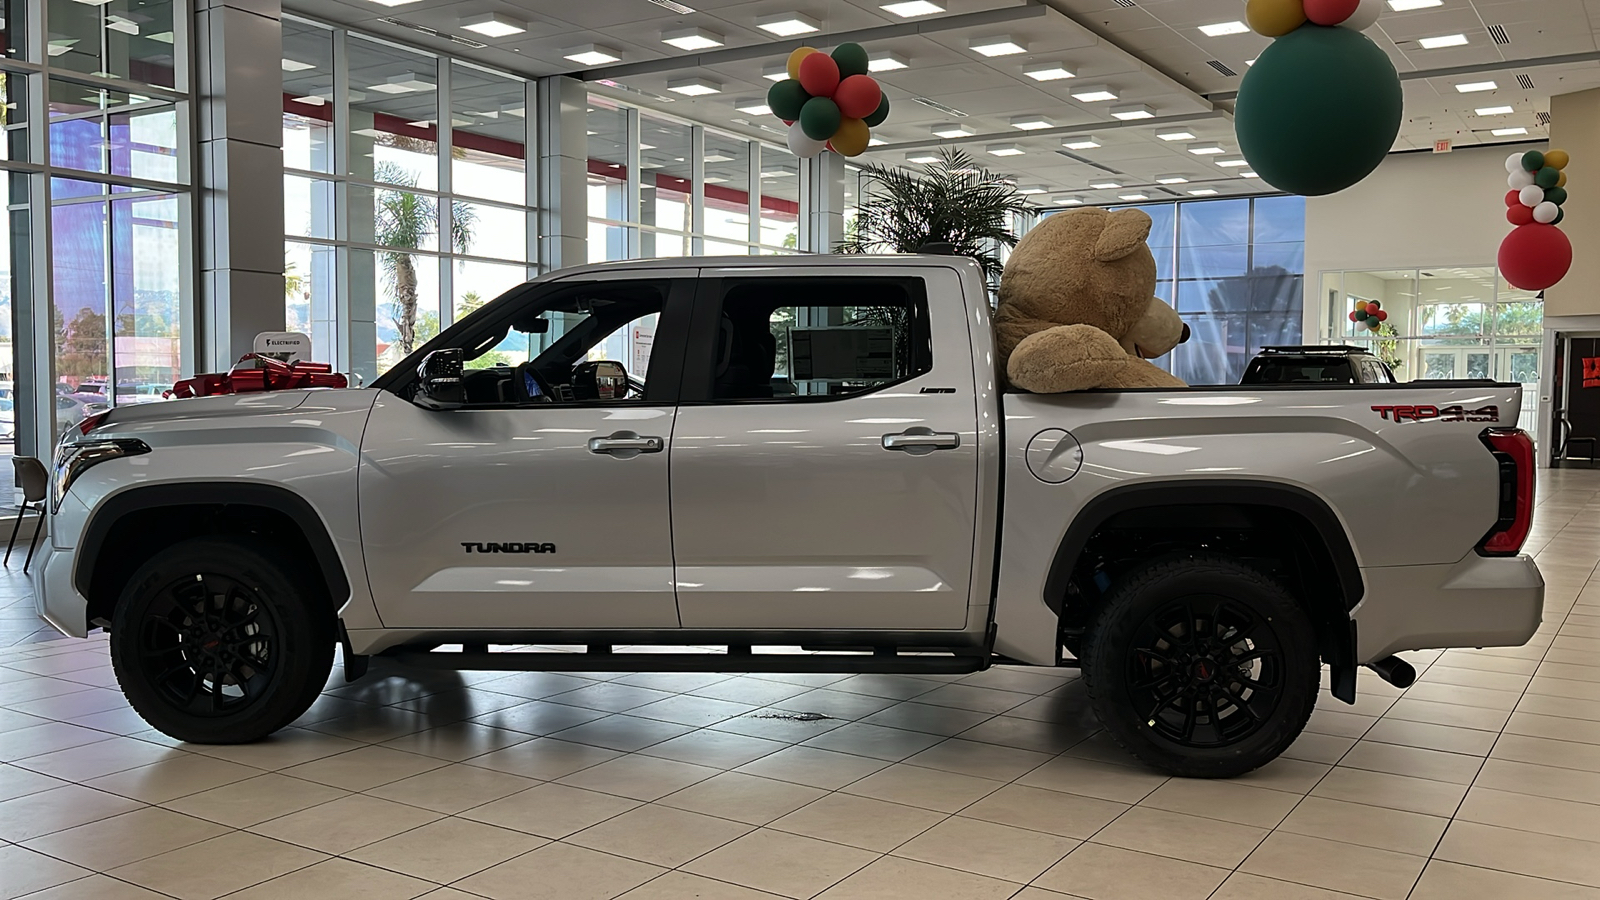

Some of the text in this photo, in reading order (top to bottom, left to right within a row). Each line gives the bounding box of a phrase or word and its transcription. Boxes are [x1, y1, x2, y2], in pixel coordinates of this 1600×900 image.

[1436, 142, 1448, 151] EXIT
[1371, 405, 1440, 423] TRD
[460, 542, 556, 553] TUNDRA
